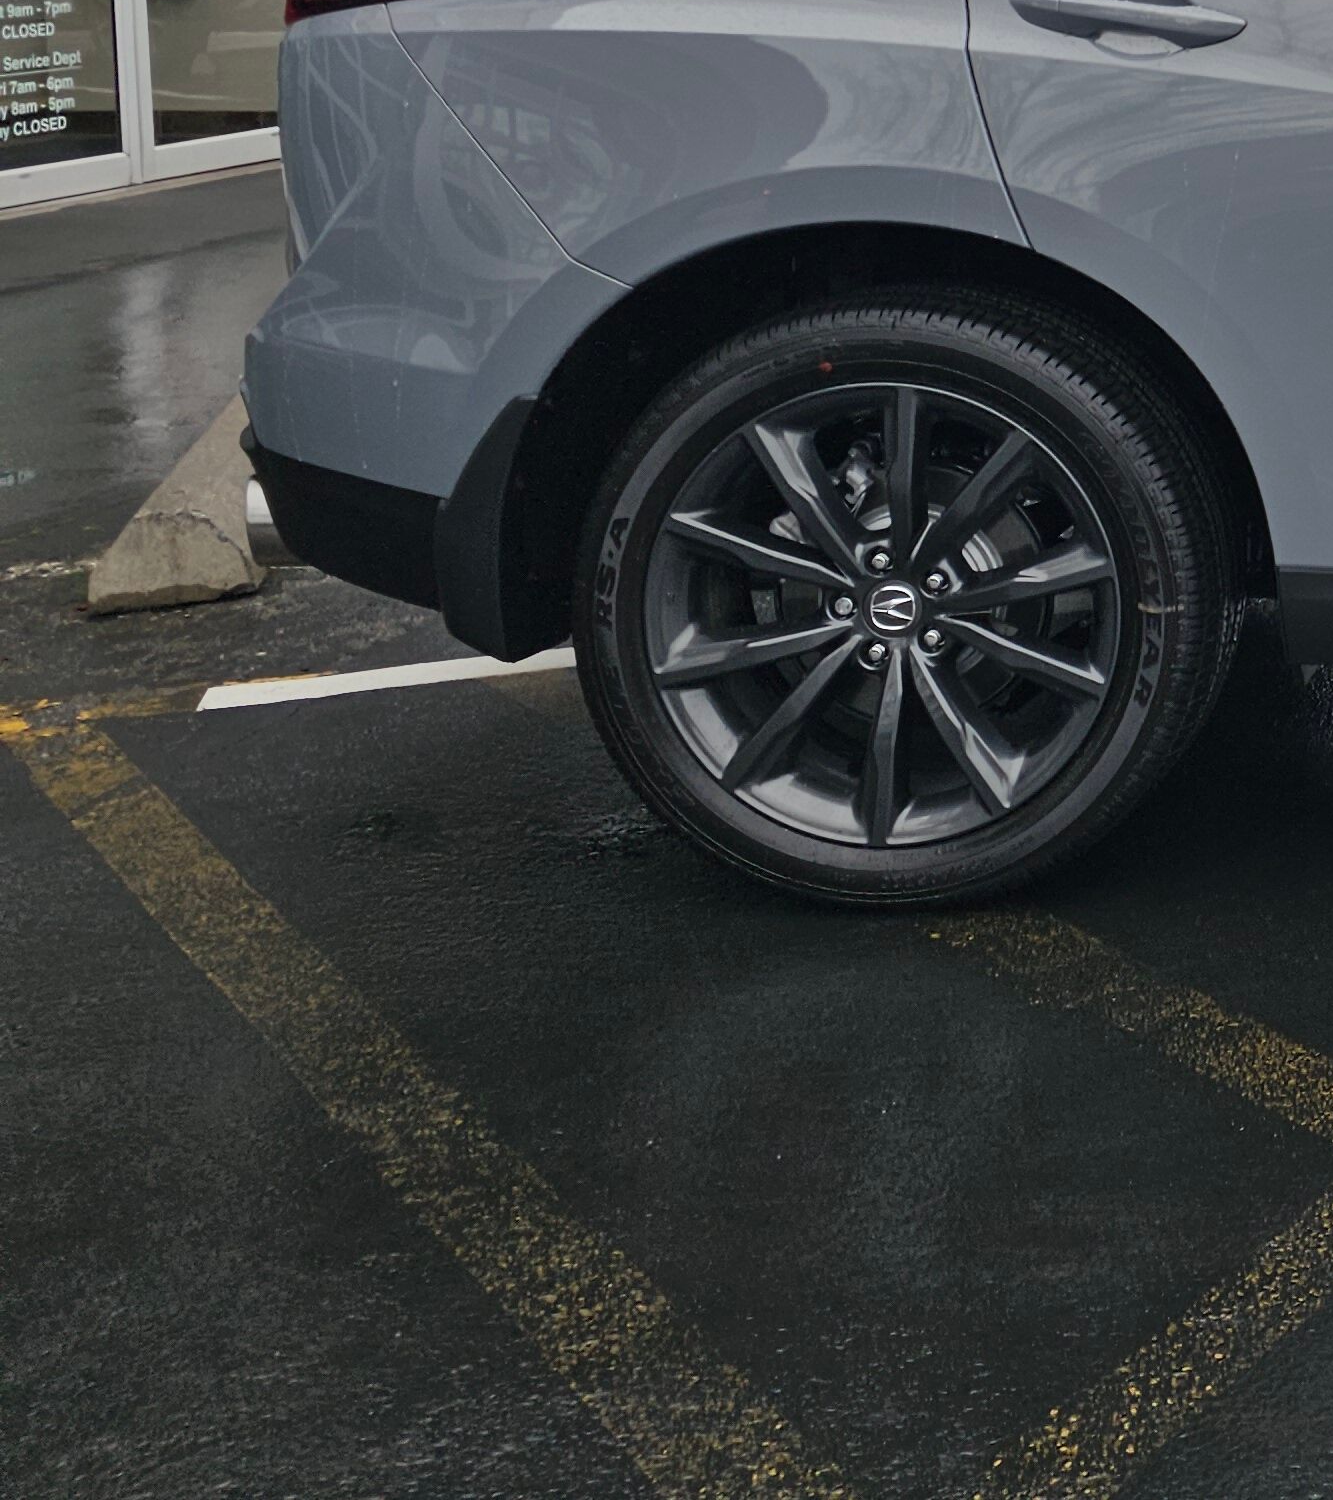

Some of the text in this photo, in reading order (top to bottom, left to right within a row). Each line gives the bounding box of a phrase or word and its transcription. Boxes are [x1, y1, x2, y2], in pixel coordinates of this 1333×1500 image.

[7, 3, 34, 19] 9am
[43, 1, 72, 18] 7pm
[2, 22, 55, 39] CLOSED
[3, 50, 82, 72] Service Dept
[9, 80, 37, 95] 7am
[46, 76, 75, 93] 6pm
[11, 101, 38, 116] 8am
[48, 96, 76, 113] 5pm
[13, 116, 67, 137] CLOSED
